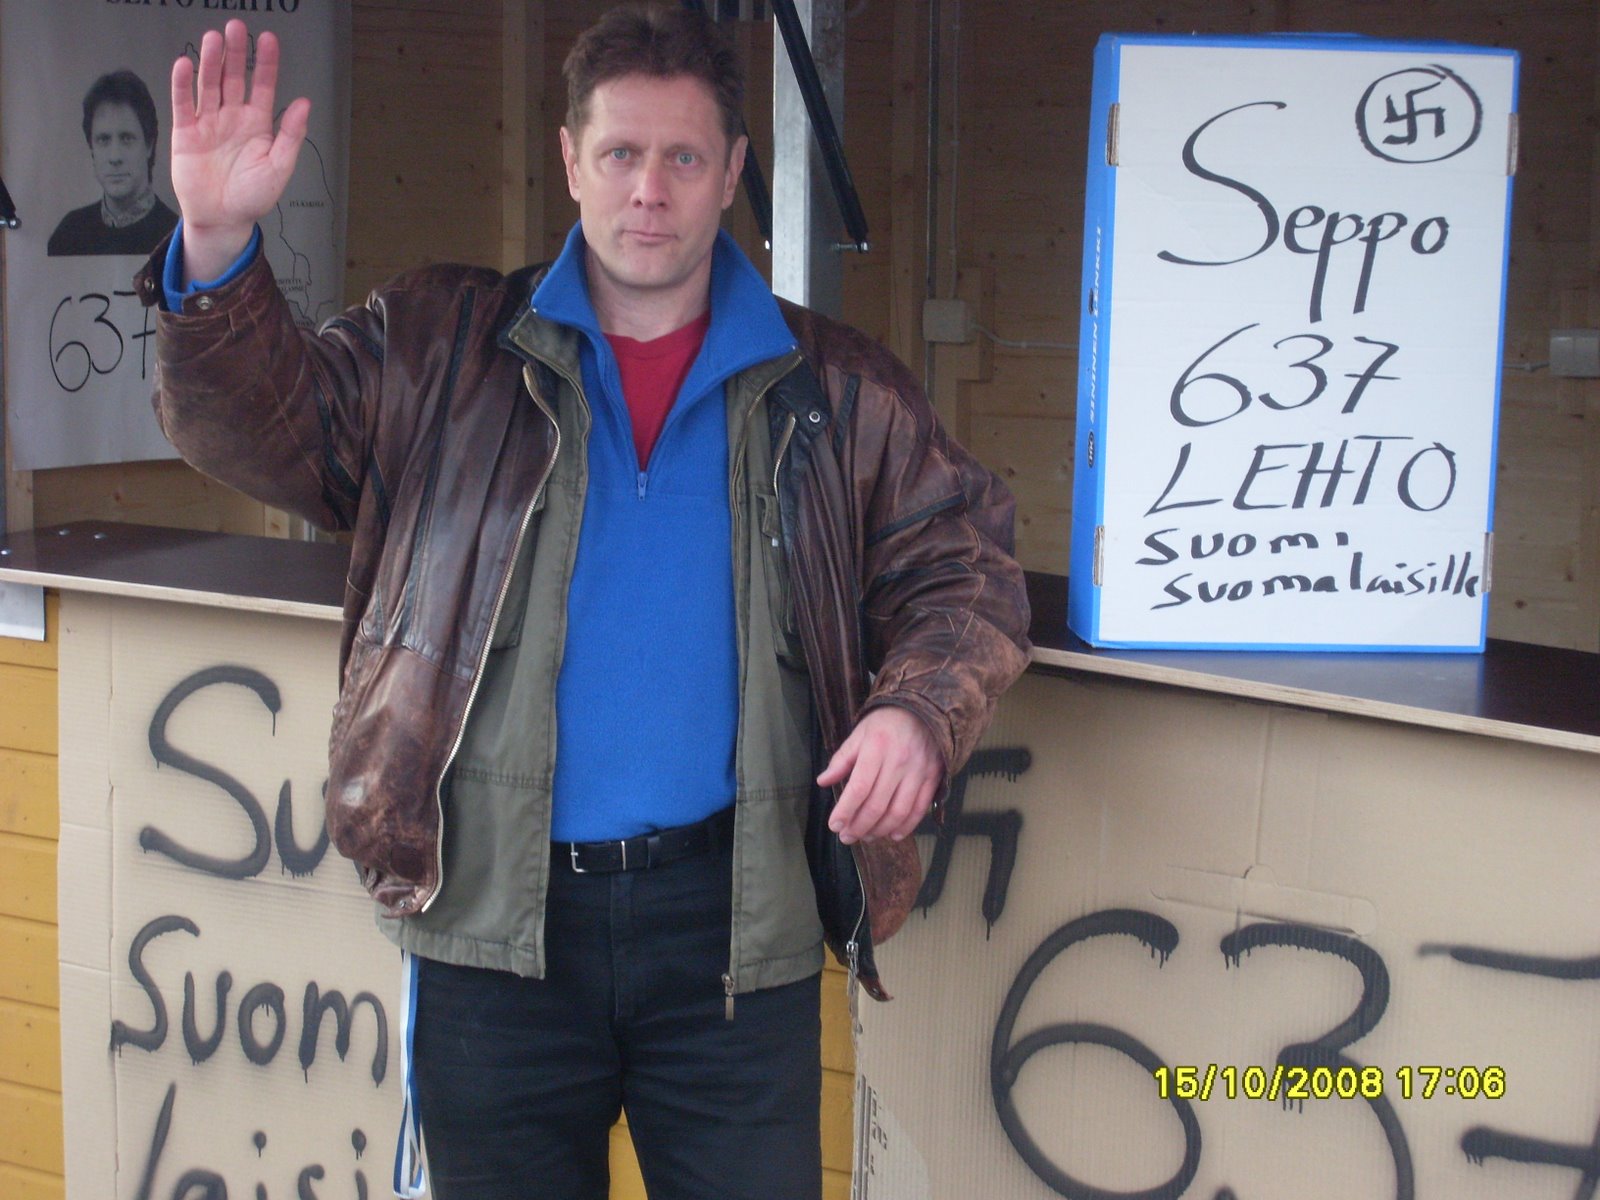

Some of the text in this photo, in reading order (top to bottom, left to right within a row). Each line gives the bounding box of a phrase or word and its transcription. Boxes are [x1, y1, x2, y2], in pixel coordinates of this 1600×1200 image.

[1157, 101, 1449, 324] Seppo
[1169, 323, 1401, 427] 637
[1144, 434, 1457, 517] LEHTO
[108, 914, 389, 1087] Suom
